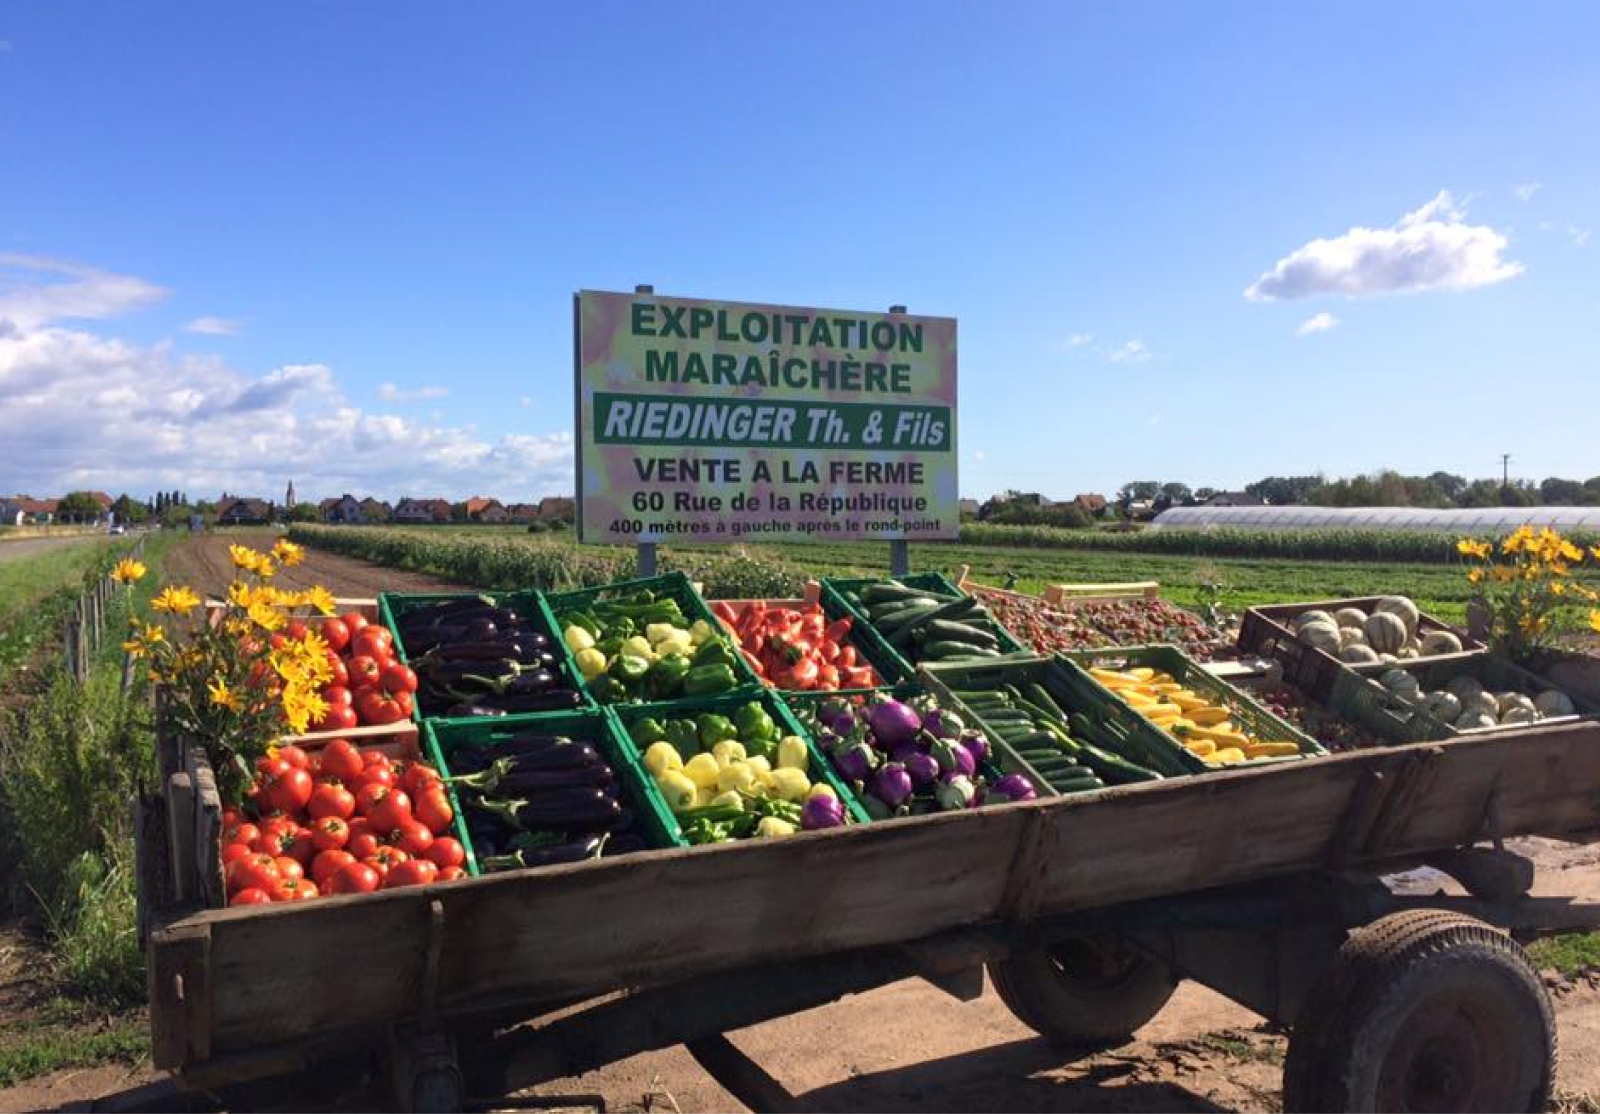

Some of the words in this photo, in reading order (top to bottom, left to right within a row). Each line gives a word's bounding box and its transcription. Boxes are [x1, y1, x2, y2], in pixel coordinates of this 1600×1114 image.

[631, 303, 923, 352] EXPLOITATION
[646, 350, 911, 393] MARAÎCHÈRE
[604, 401, 797, 442] RIEDINGER
[806, 408, 850, 444] Th.
[862, 410, 884, 444] &
[893, 412, 945, 447] Fils
[634, 458, 741, 483] VENTE
[752, 460, 772, 484] A
[782, 460, 820, 484] LA
[830, 461, 924, 484] FERME
[633, 491, 664, 512] 60
[674, 492, 721, 512] Rue
[730, 492, 760, 512] de
[770, 492, 791, 512] la
[800, 492, 927, 515] République
[609, 519, 643, 533] 400
[648, 519, 710, 533] mètres
[716, 519, 725, 533] à
[731, 519, 791, 536] gauche
[797, 519, 841, 535] après
[845, 519, 861, 532] le
[864, 519, 941, 533] rond-point
